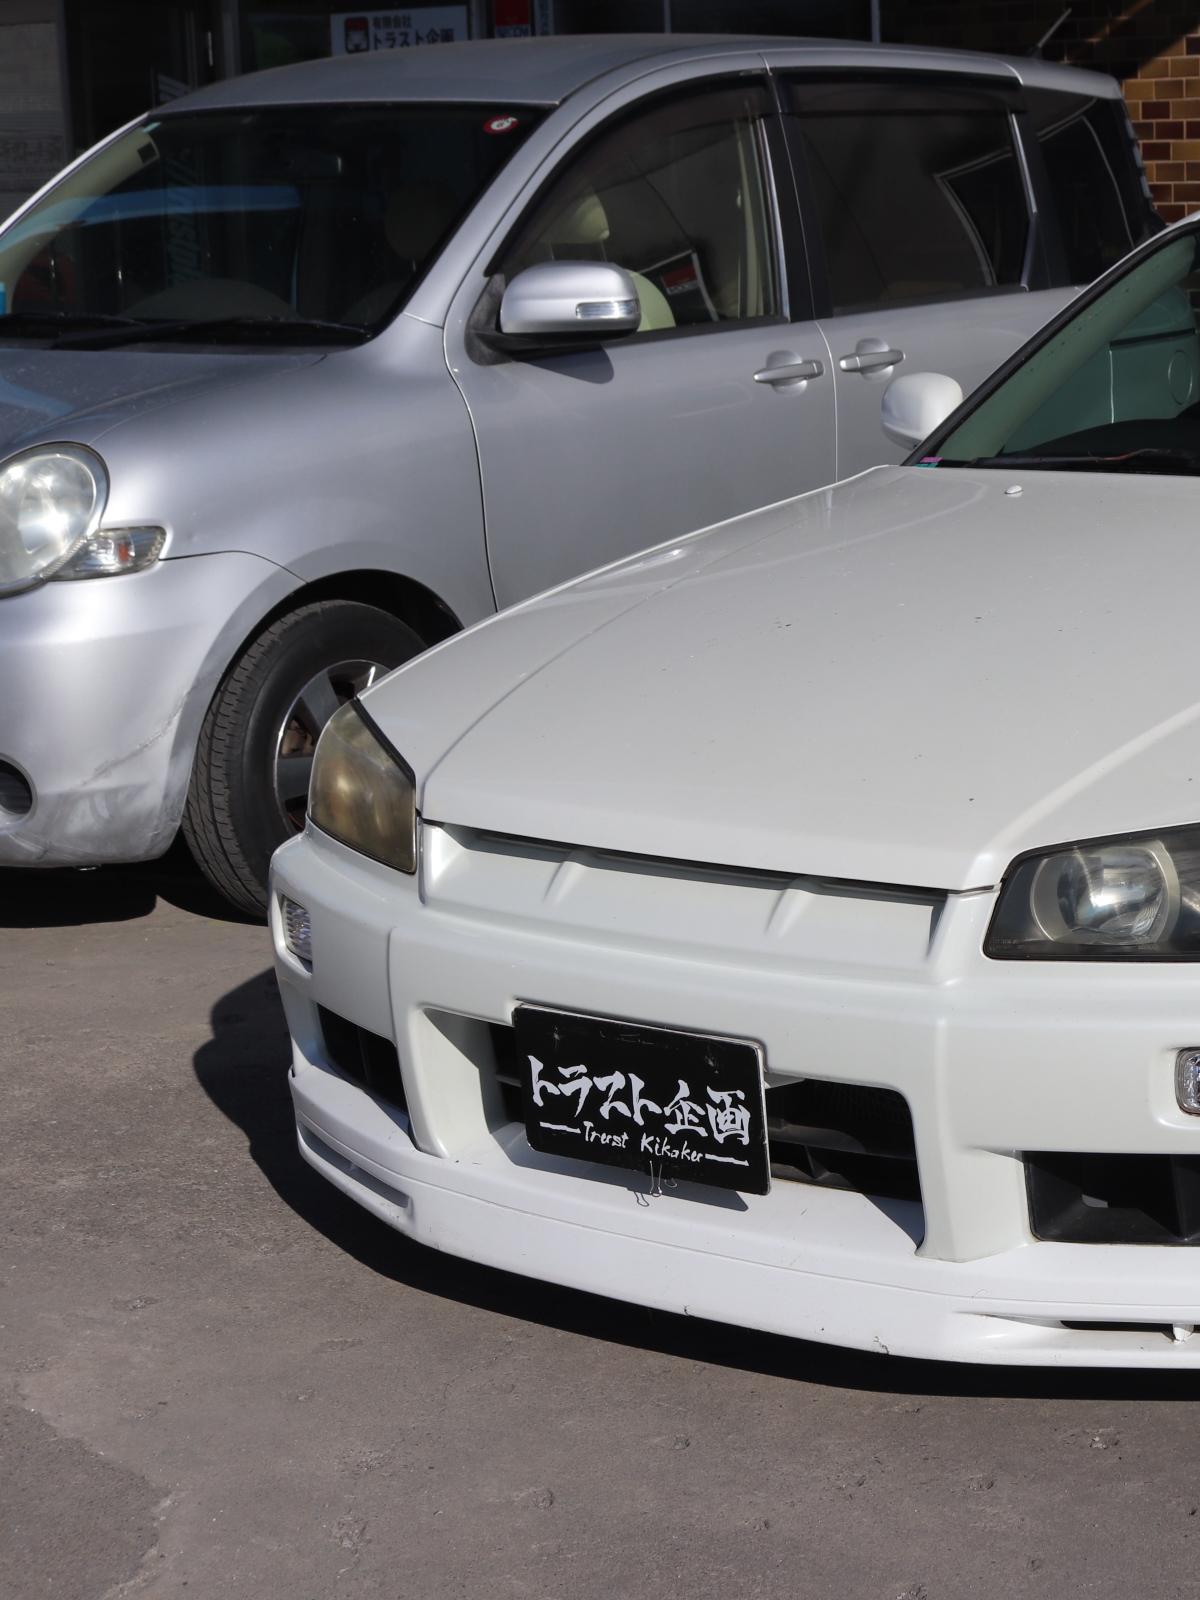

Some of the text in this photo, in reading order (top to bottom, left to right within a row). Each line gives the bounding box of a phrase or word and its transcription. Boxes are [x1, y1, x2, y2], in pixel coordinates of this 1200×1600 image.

[372, 14, 412, 29] 有限会社
[373, 28, 454, 50] トラスト企画
[527, 1055, 751, 1146] トラスト企画
[583, 1121, 704, 1163] Trust Kikaku
